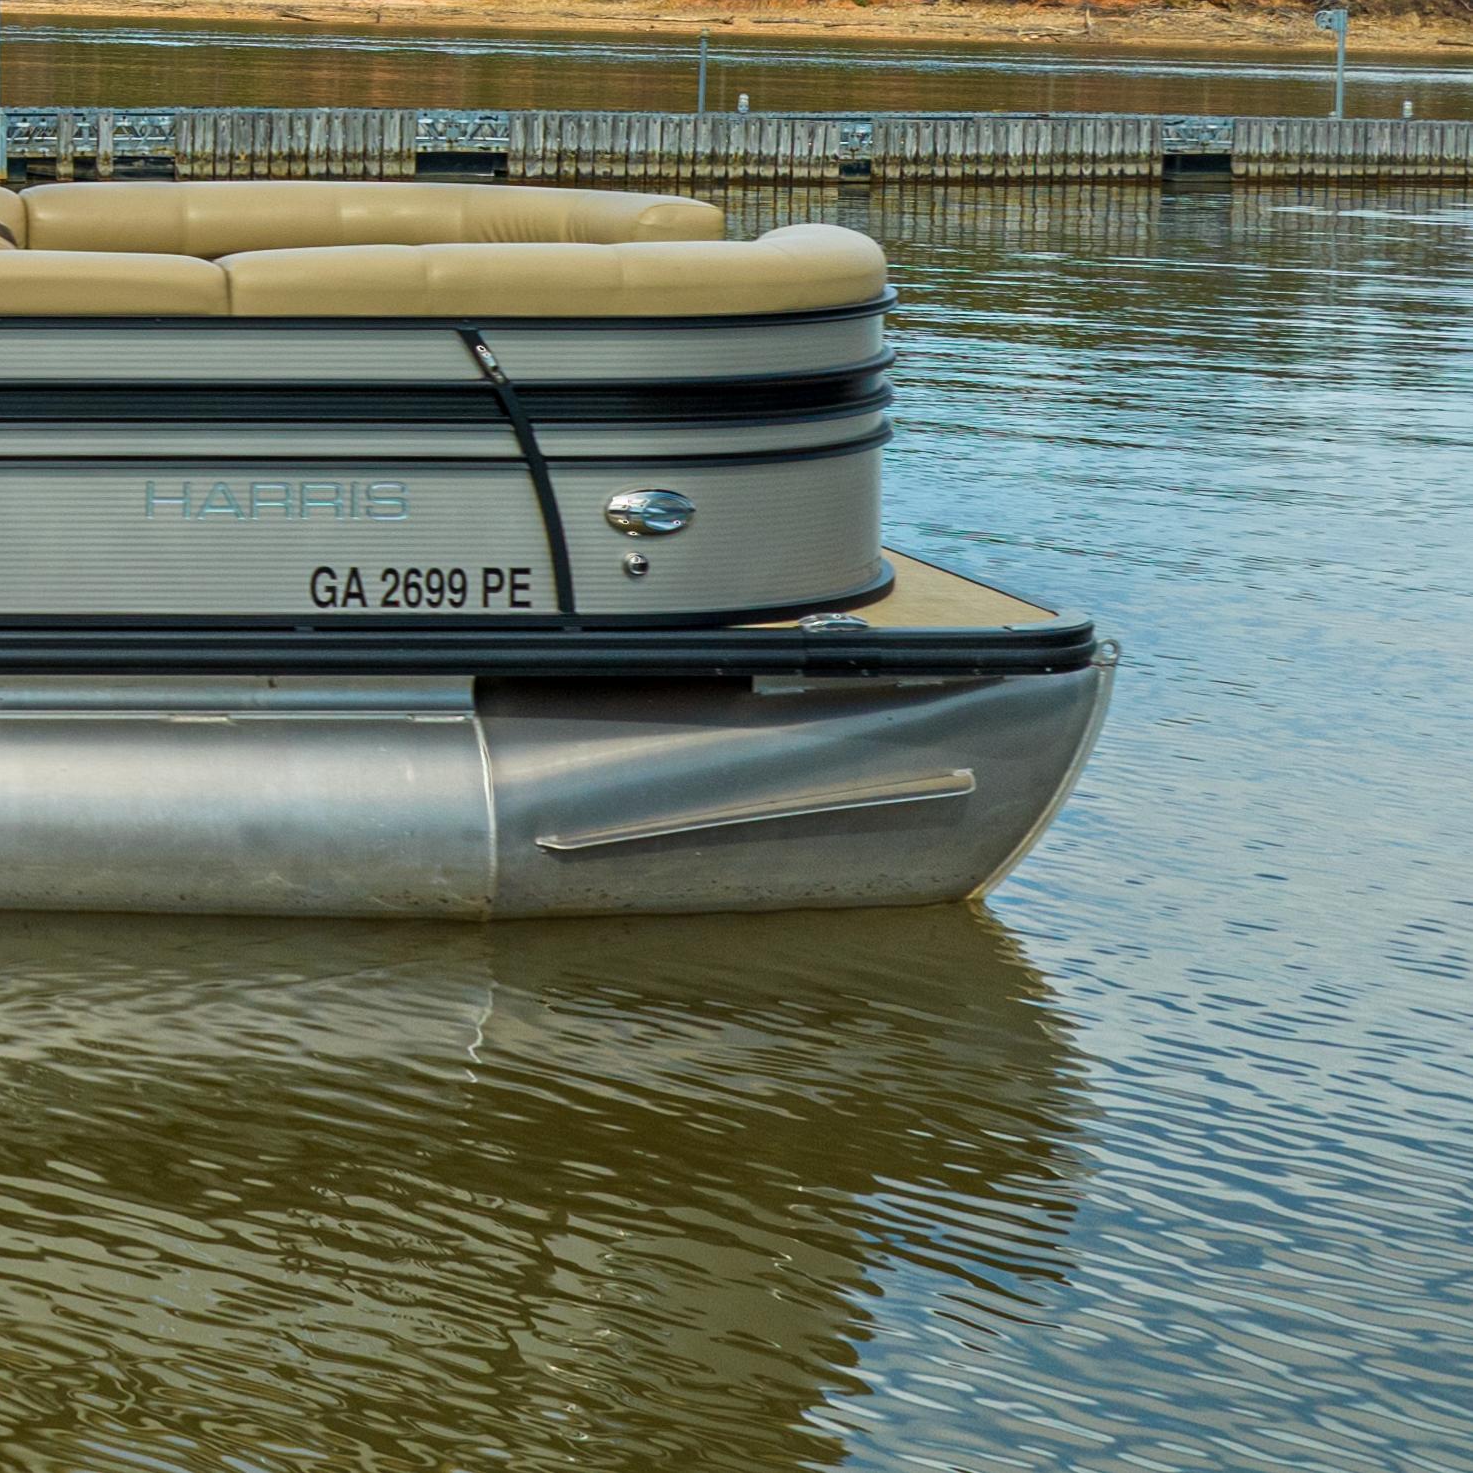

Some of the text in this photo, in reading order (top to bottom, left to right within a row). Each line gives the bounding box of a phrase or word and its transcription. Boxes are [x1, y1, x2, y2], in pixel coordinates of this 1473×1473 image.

[144, 479, 410, 521] HARRIS
[310, 566, 533, 609] GA 2699 PE
